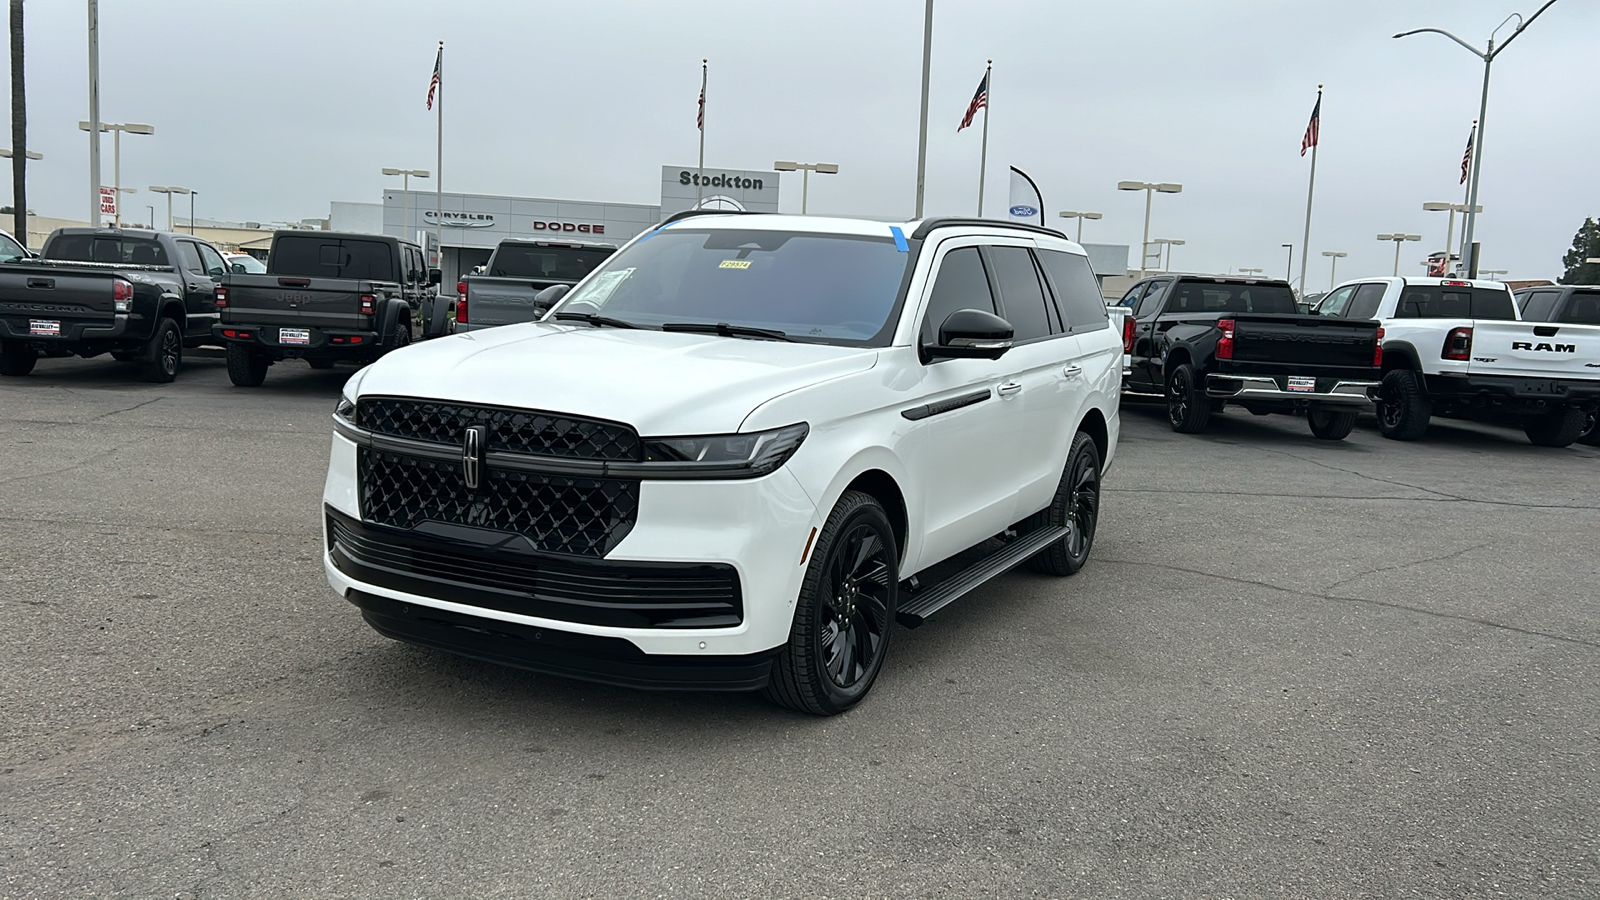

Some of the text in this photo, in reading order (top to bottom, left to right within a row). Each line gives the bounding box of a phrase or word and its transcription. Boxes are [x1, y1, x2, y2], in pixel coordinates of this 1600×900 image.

[680, 171, 763, 190] Stockton
[101, 204, 115, 214] CARS
[1013, 207, 1032, 215] Ford
[425, 211, 494, 221] CHRYSLER
[533, 221, 605, 235] DODGE
[277, 292, 310, 305] Jeep
[2, 302, 85, 313] TACOMA
[1244, 331, 1369, 345] CHEVROLET
[1512, 342, 1575, 353] RAM
